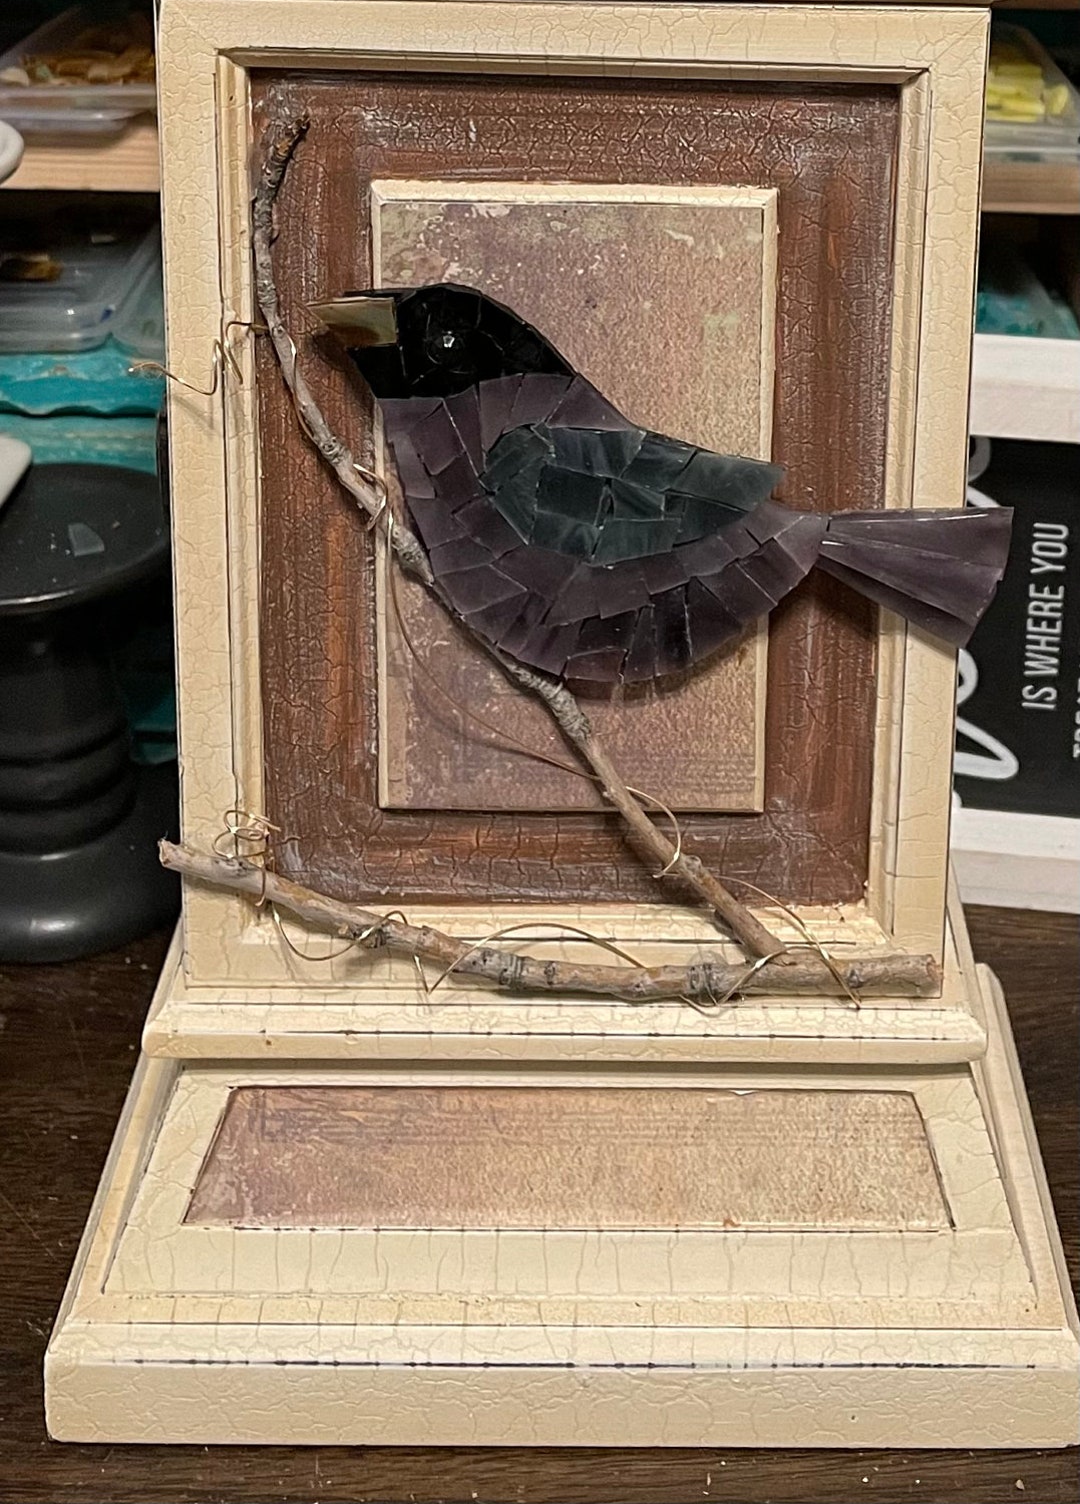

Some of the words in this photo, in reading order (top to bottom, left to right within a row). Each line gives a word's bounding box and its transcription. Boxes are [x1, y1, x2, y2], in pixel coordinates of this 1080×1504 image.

[1029, 522, 1070, 581] YOU
[1023, 584, 1065, 677] WHERE
[1022, 683, 1058, 711] IS
